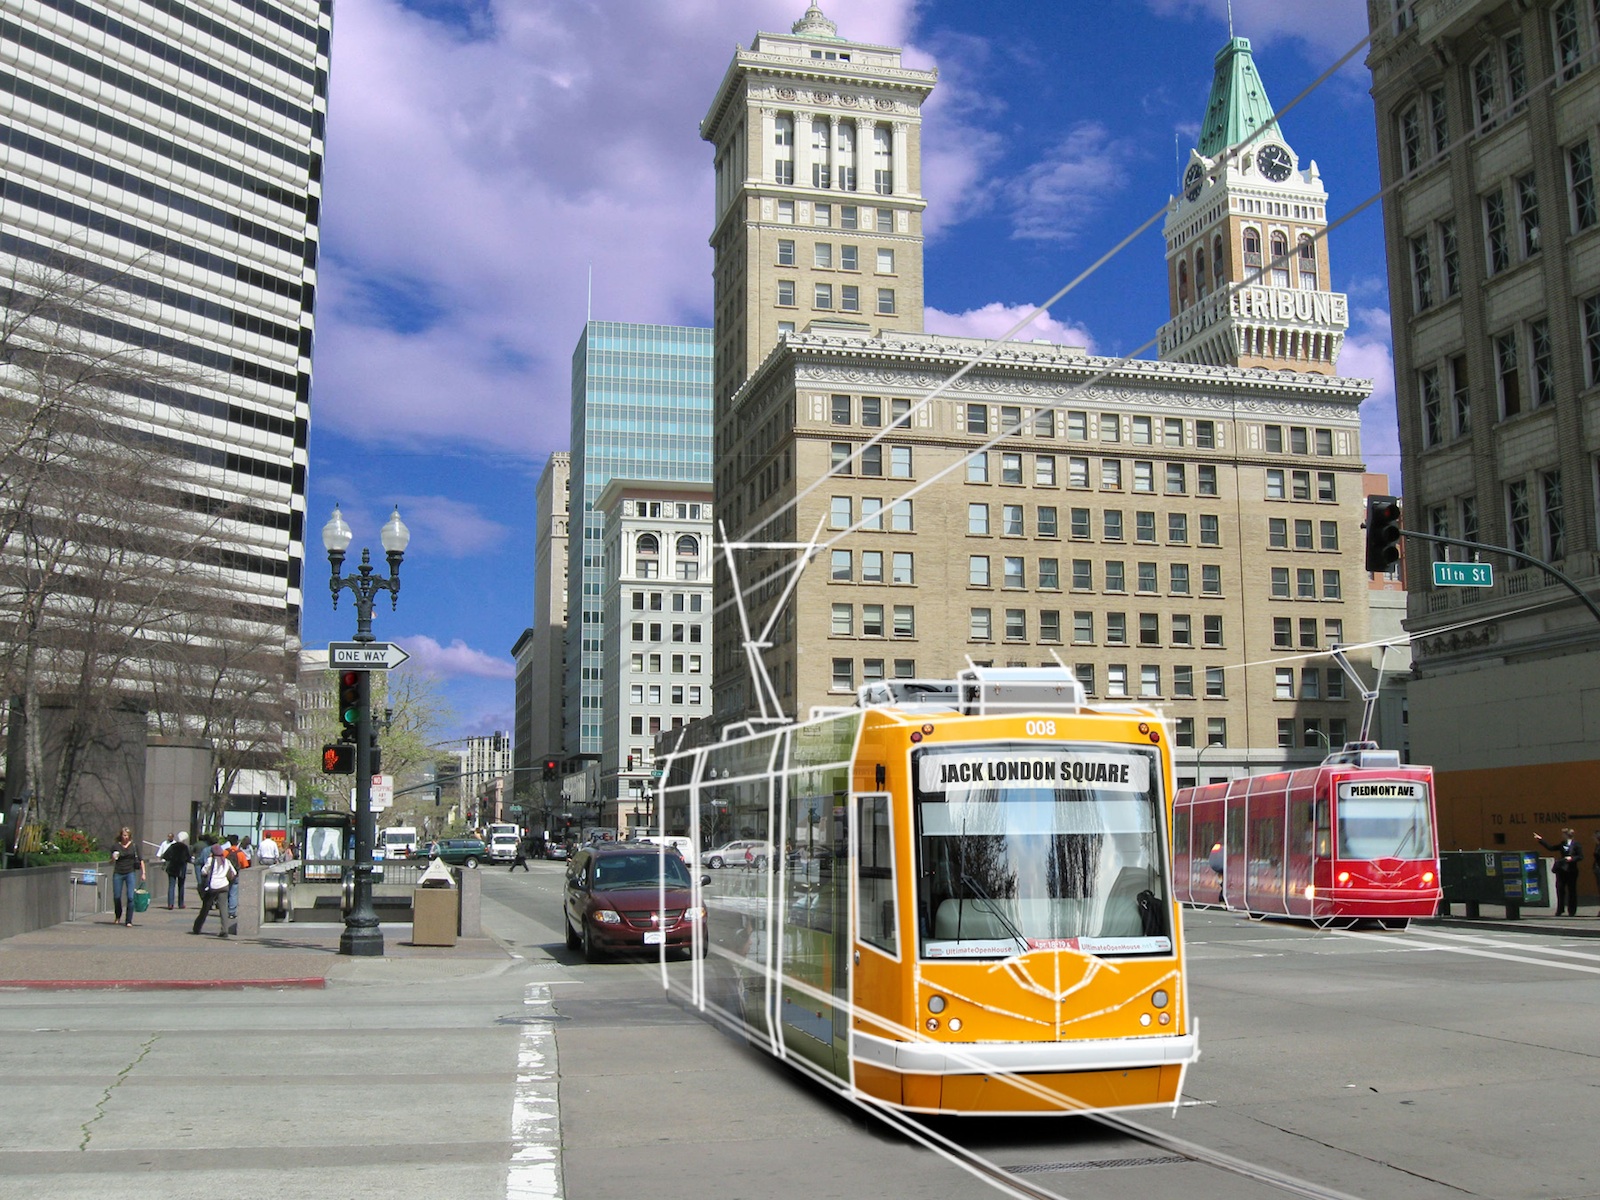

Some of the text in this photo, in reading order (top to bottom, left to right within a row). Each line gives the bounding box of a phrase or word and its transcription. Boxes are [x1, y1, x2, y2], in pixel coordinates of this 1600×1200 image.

[1233, 284, 1347, 326] TRIBUNE
[1441, 567, 1486, 581] 11th St
[338, 651, 386, 661] ONE WAY
[1026, 720, 1056, 736] 008
[940, 761, 1129, 783] JACK LONDON SQUARE
[1351, 786, 1414, 797] PIEDMONT AVE
[1491, 812, 1567, 825] TO ALL TRAINS
